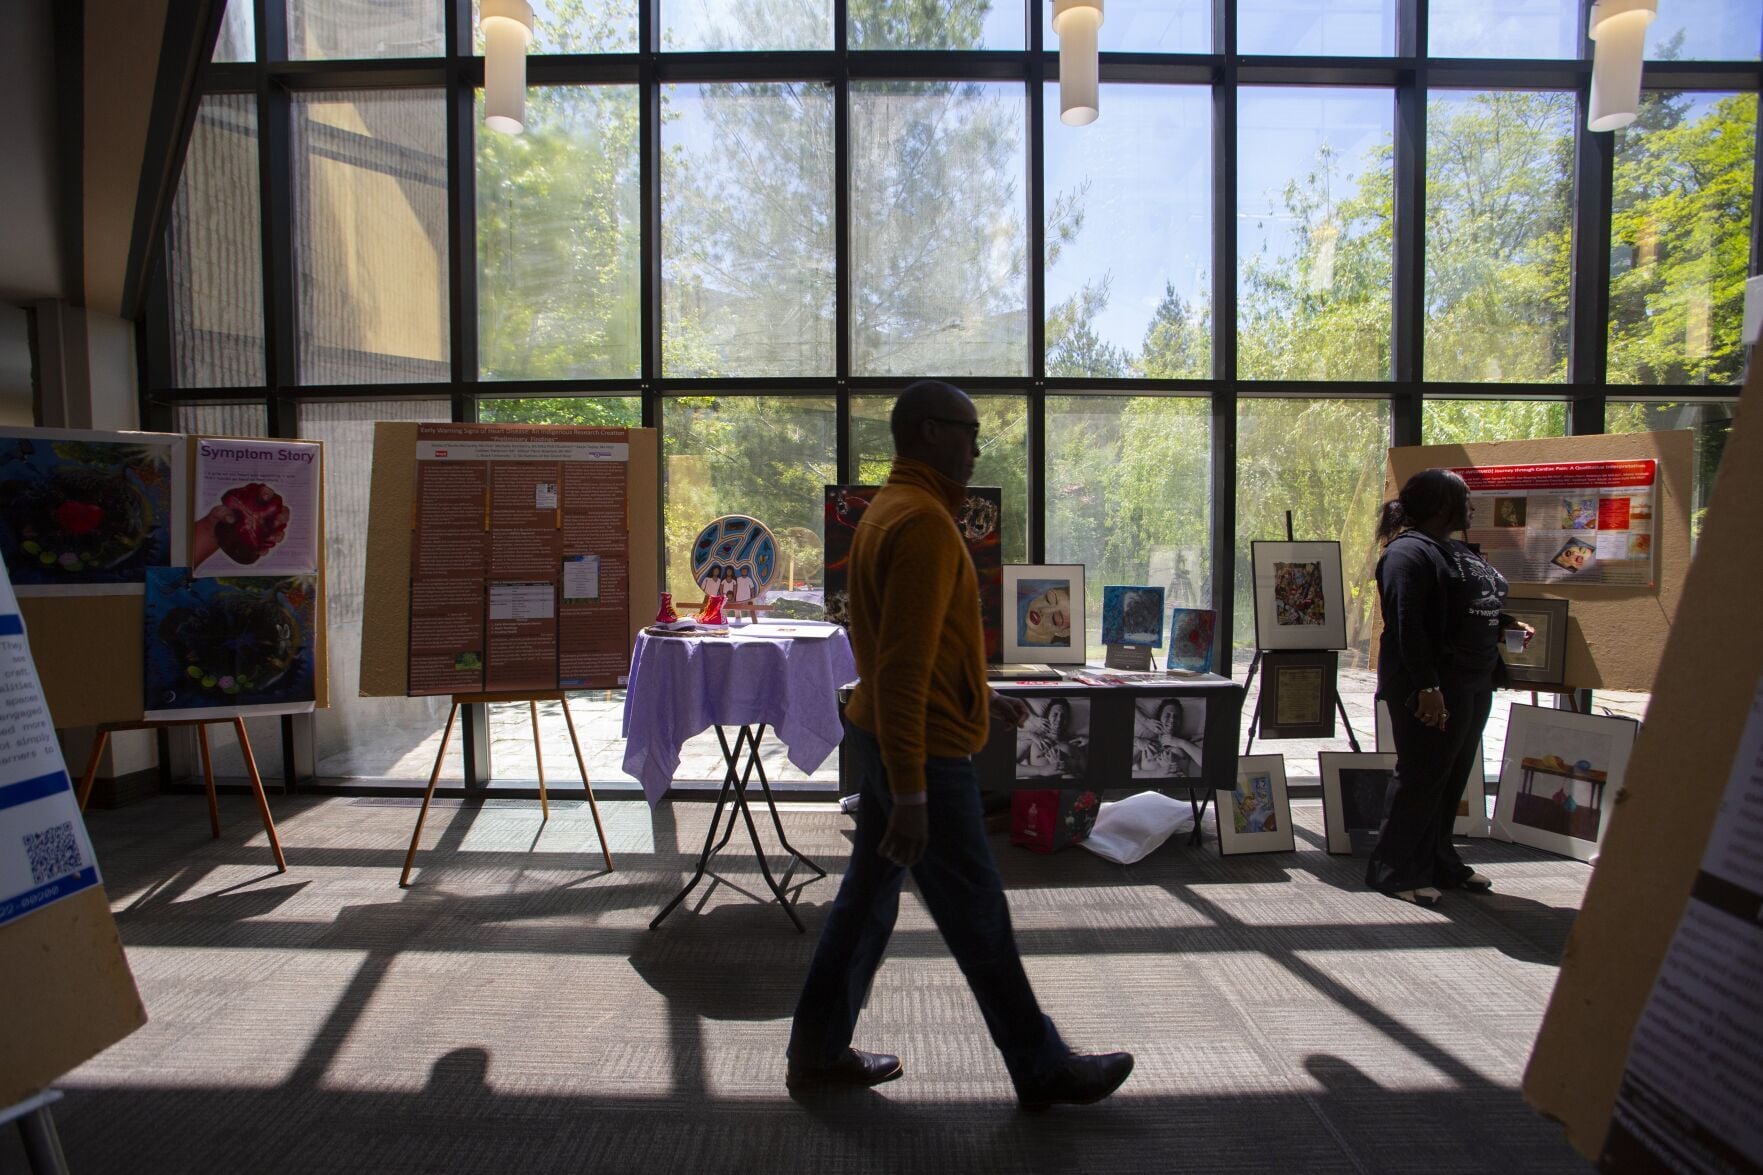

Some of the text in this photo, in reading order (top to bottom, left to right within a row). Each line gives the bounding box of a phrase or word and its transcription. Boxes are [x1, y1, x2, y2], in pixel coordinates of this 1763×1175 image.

[200, 445, 315, 464] Symptom Story
[23, 720, 47, 732] more
[16, 733, 51, 748] simply
